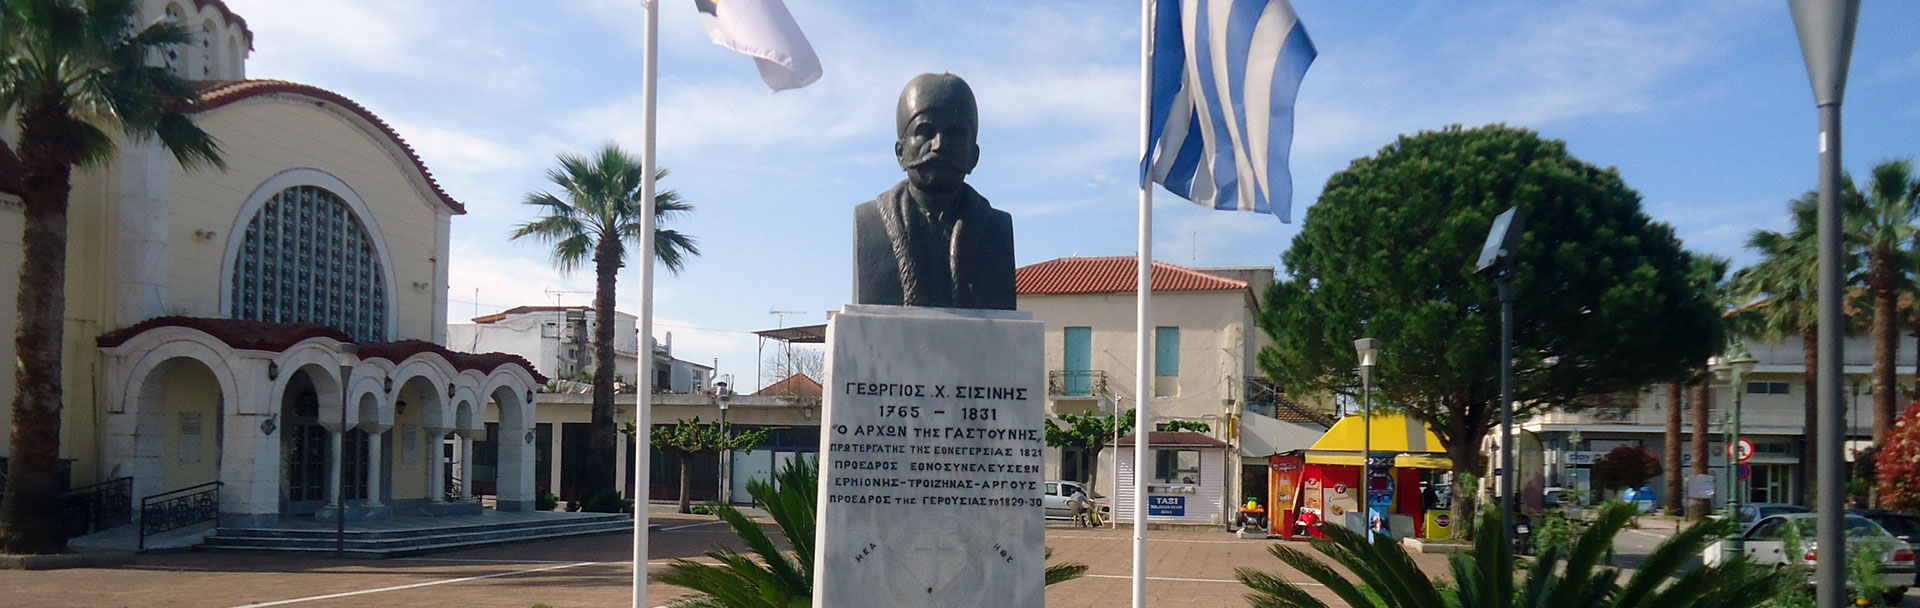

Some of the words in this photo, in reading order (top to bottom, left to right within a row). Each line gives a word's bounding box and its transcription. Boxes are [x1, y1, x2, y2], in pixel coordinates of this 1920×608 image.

[845, 382, 925, 398] ΓΕΩΡΓΙΟΣ
[955, 386, 1028, 401] ΣΙΣΙΝΗΣ
[879, 405, 921, 418] 1765
[961, 408, 998, 421] 1831
[853, 425, 907, 438] ΑΡΧΩΝ
[830, 443, 906, 454] ΠΡΩΤΕΡΓΑΤΗΣ
[909, 445, 931, 455] ΤΗΣ
[933, 446, 1013, 457] ΕΘΝΕΓΕΡΣΙΑΣ
[1019, 448, 1043, 458] 1821
[834, 460, 899, 471] ΠΡΟΕΔΡΟΣ
[910, 461, 1040, 474] ΕΘΝΟΣΥΝΕΛΕΥΣΕΩΝ
[829, 494, 892, 505] ΠΡΟΕΔΡΟΣ
